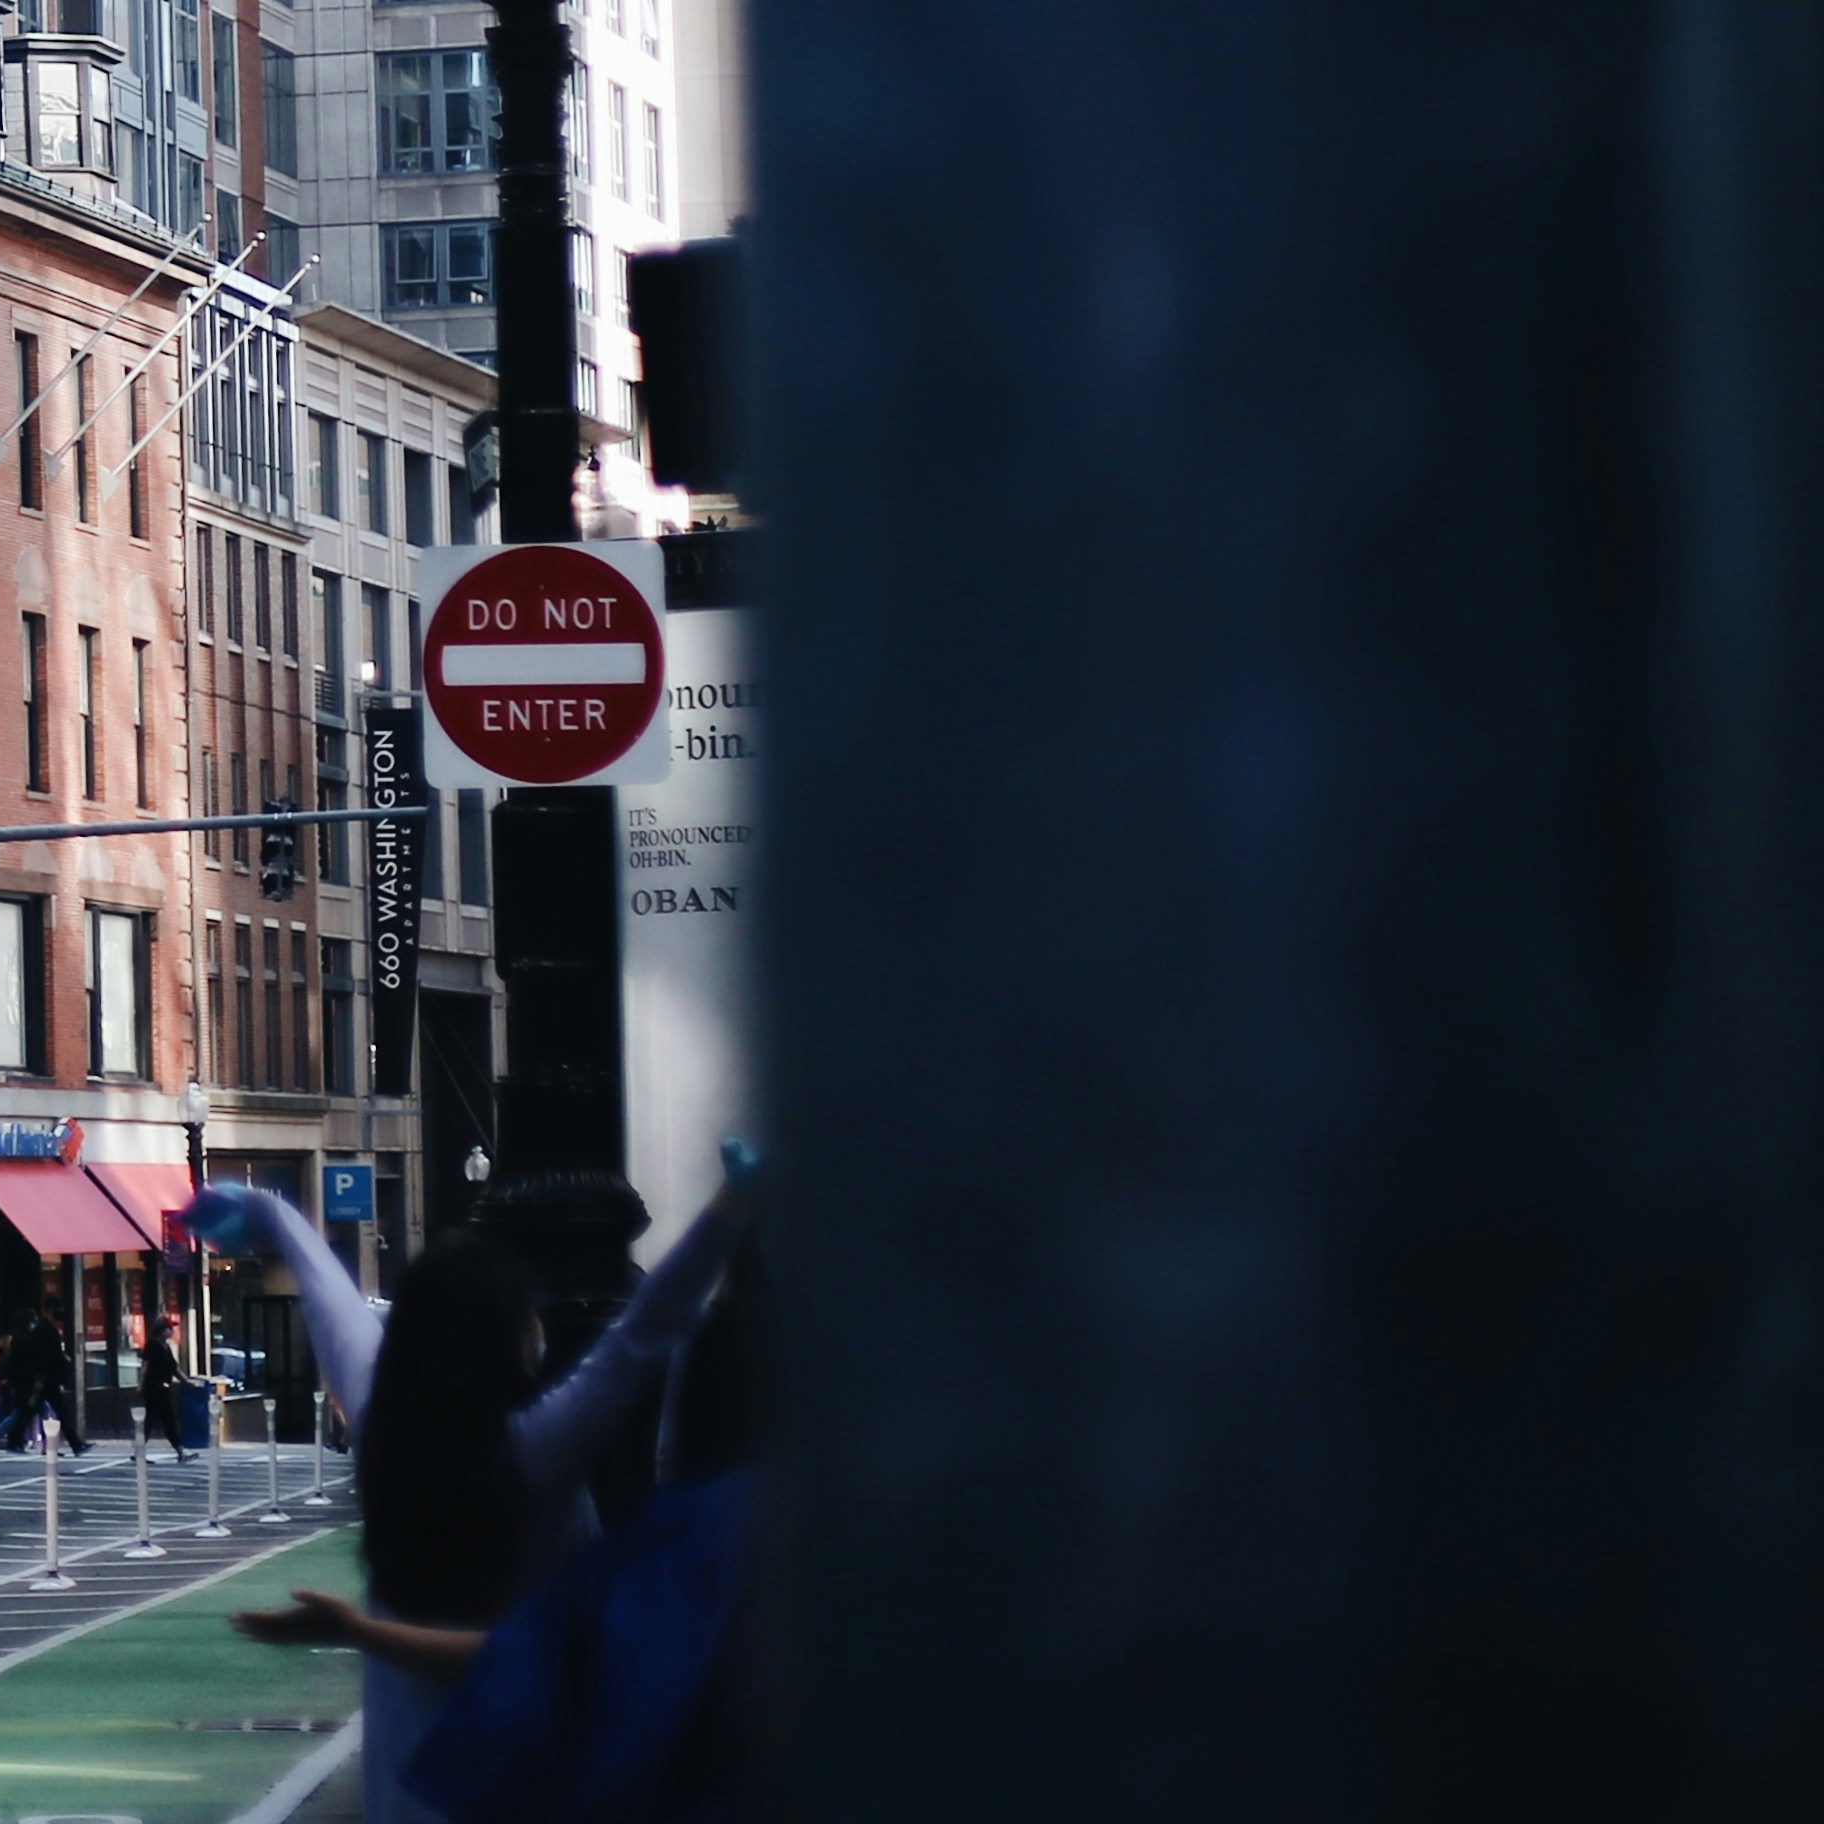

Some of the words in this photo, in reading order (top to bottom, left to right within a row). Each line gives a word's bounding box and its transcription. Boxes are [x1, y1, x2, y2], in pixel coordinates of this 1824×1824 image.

[468, 599, 517, 630] DO
[544, 597, 618, 629] NOT
[483, 699, 607, 731] ENTER
[628, 808, 657, 827] IT'S
[629, 825, 752, 848] PRONOUNCED
[400, 772, 414, 945] APARTMETS
[629, 849, 692, 869] OH-BIN.
[631, 886, 740, 916] OBAN
[378, 932, 400, 989] 660
[334, 1173, 355, 1195] P
